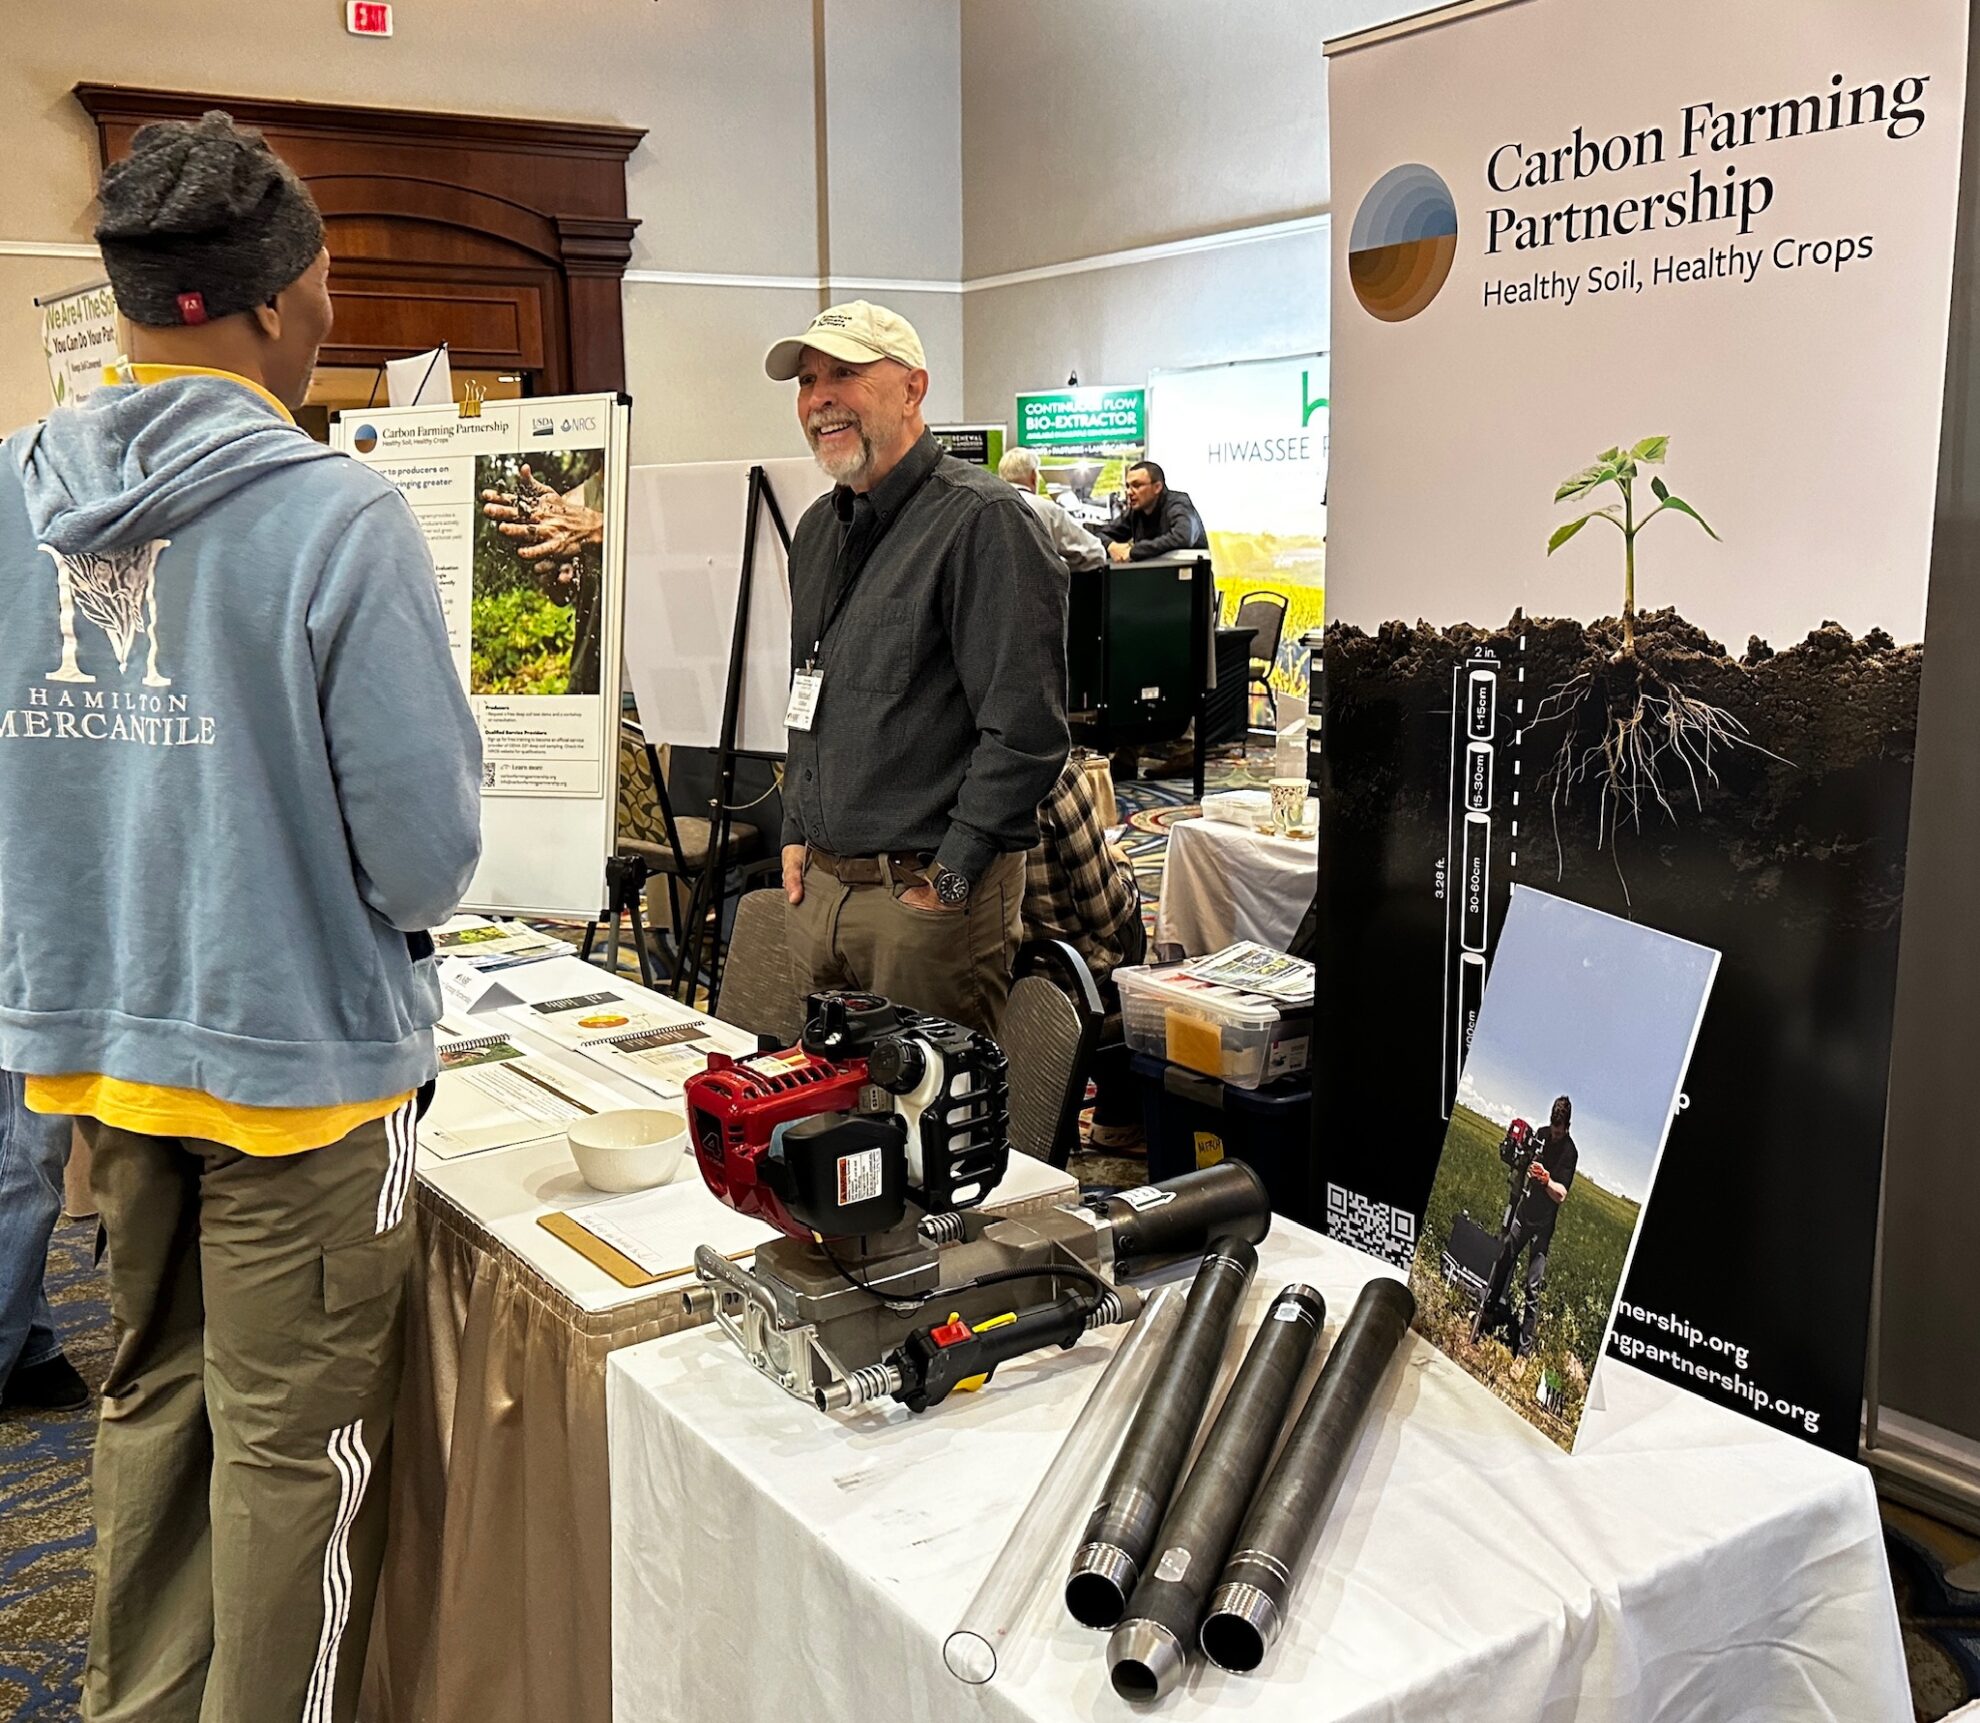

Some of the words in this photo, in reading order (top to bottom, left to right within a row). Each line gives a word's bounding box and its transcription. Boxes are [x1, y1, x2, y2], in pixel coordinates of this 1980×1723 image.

[1486, 127, 1666, 192] Carbon
[1678, 74, 1931, 158] Farming
[1484, 164, 1774, 254] Partnership
[1484, 271, 1579, 307] Healthy
[1588, 259, 1643, 294] Soil,
[1654, 243, 1763, 286] Healthy
[1773, 235, 1873, 273] Crops
[53, 337, 66, 353] You
[66, 334, 78, 351] Can
[78, 332, 88, 349] Do
[87, 329, 102, 346] Your
[1103, 397, 1137, 411] FLOW
[382, 427, 415, 439] Carbon
[417, 424, 455, 438] Farming
[456, 421, 509, 435] Partnership
[572, 416, 597, 431] NRCS
[1026, 411, 1137, 430] BIO-EXTRACTOR
[382, 440, 401, 448] Healthy
[413, 438, 432, 446] Healthy
[433, 437, 449, 445] Crops
[1209, 436, 1310, 464] HIWASSEE
[388, 467, 397, 475] to
[397, 465, 437, 477] producers
[423, 479, 453, 489] greater
[1475, 647, 1482, 657] 2
[1483, 648, 1497, 658] in.
[29, 688, 188, 712] HAMILTON
[1475, 686, 1487, 731] 1-15cm
[0, 710, 216, 745] MERCANTILE
[1473, 754, 1485, 808] 15-30cm
[1437, 856, 1446, 870] ft.
[1435, 871, 1445, 899] 3.28
[1470, 857, 1481, 914] 30-60cm
